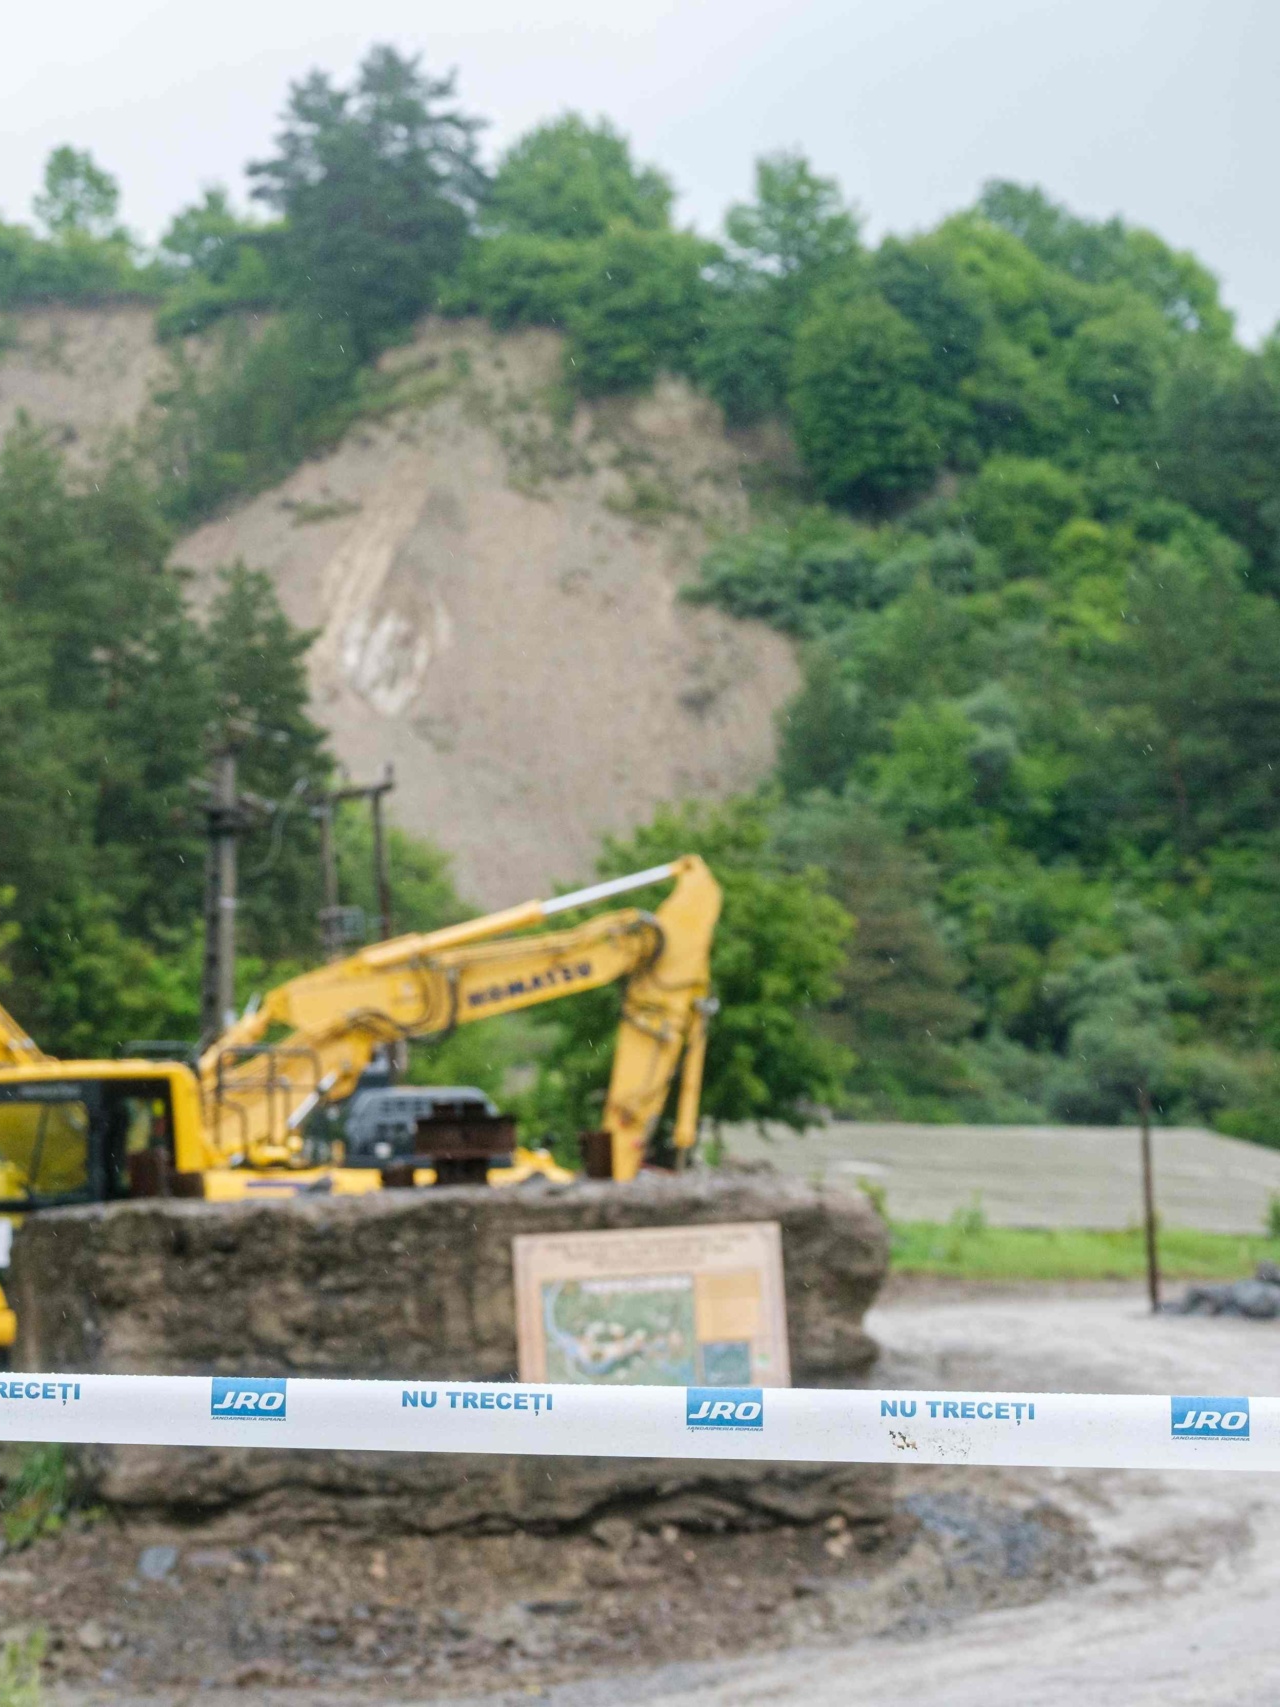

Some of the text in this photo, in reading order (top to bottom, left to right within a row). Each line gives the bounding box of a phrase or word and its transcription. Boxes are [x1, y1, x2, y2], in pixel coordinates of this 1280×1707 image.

[213, 1391, 284, 1410] JRO
[402, 1391, 553, 1416] NU TRECEȚI
[688, 1401, 761, 1420] JRO
[881, 1400, 1035, 1426] NU TRECEȚI
[1173, 1411, 1248, 1430] JRO
